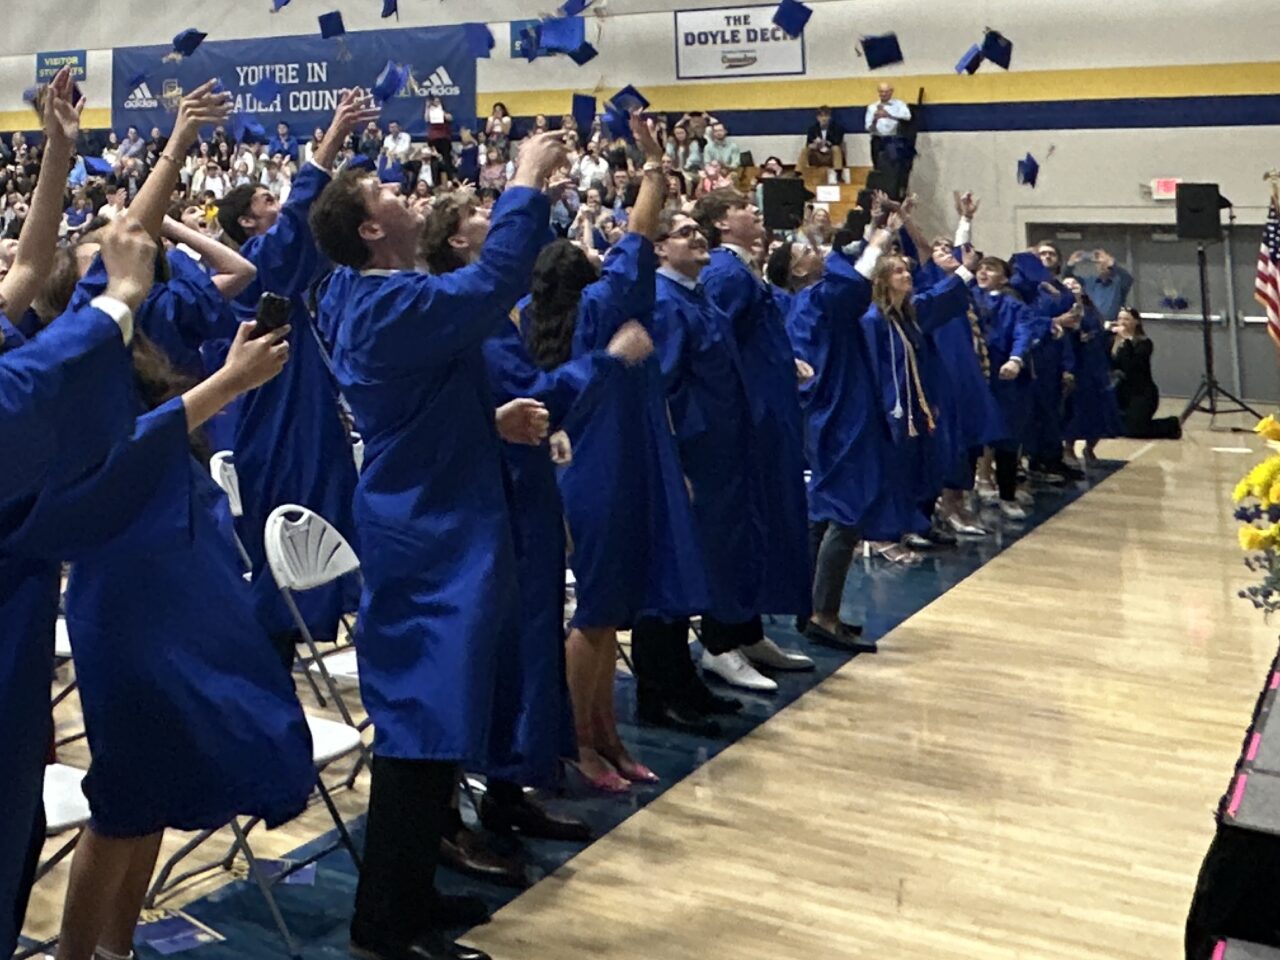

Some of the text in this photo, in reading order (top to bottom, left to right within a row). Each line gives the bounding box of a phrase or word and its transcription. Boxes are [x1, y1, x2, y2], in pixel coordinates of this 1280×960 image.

[724, 14, 751, 26] THE
[683, 27, 795, 47] DOYLE DEC
[44, 55, 79, 66] VISITOR
[306, 62, 328, 83] IN
[417, 84, 461, 97] adidas
[124, 98, 158, 109] adidas
